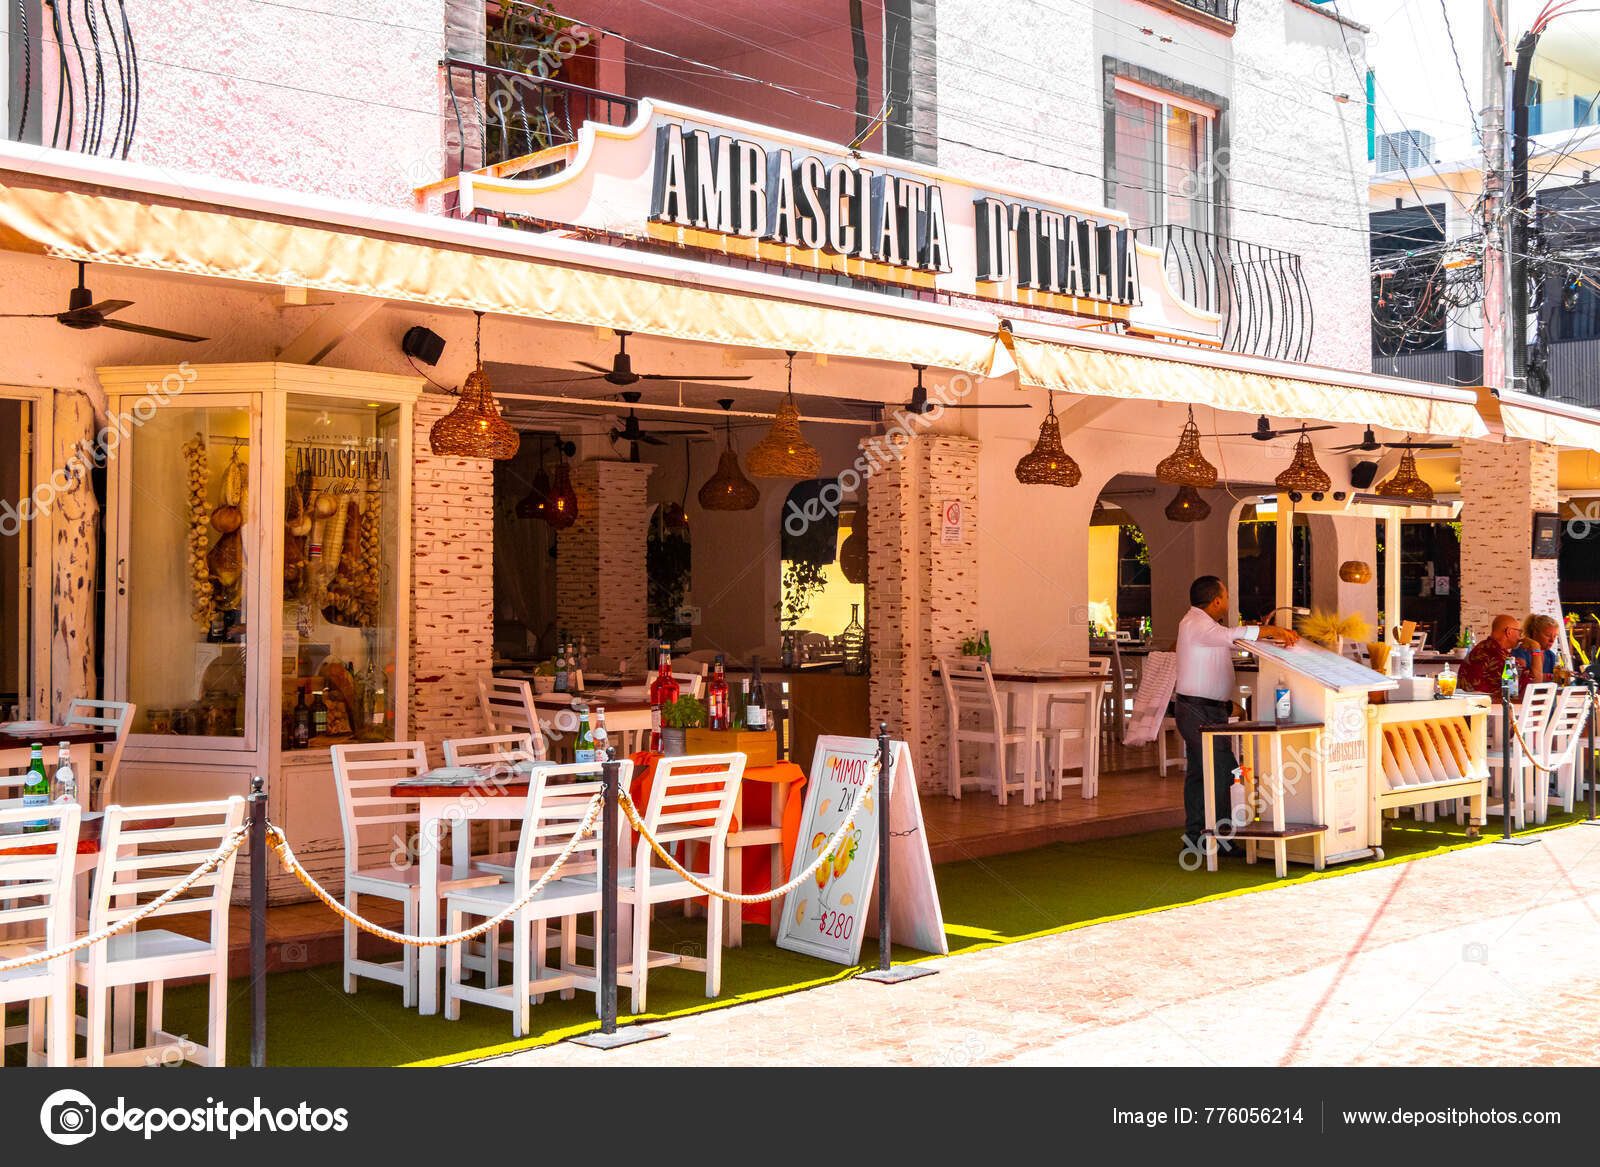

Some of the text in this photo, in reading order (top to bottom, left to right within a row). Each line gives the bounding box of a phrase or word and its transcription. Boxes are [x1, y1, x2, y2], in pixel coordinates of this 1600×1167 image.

[649, 123, 1143, 307] AMBASCIATA D'ITALIA
[295, 447, 390, 480] AMBASCIATA
[819, 910, 854, 940] $280
